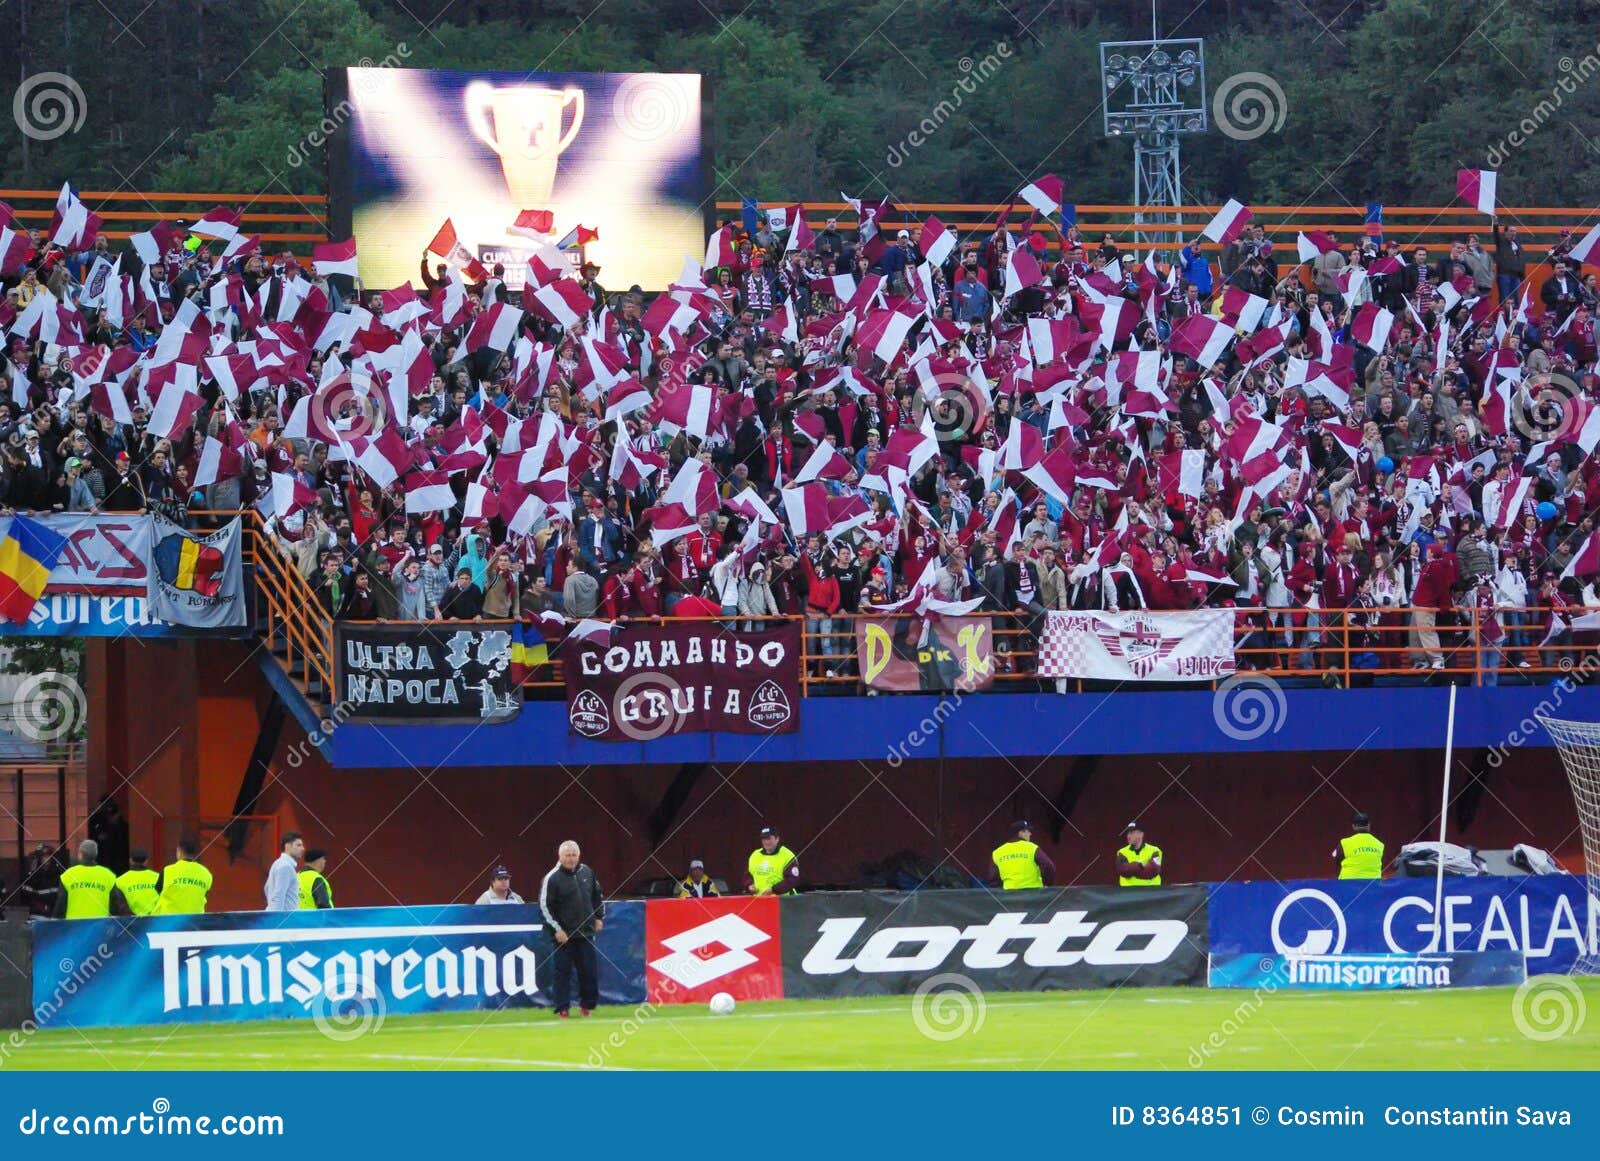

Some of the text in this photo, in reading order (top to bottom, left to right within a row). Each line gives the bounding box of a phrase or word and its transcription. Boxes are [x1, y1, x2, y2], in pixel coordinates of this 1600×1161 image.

[346, 639, 435, 670] ULTRA
[581, 636, 785, 675] COMMANDO
[347, 673, 460, 704] NAPOCA
[70, 881, 106, 892] STEWARD
[172, 877, 207, 889] STEWARD
[801, 910, 1189, 975] lotto
